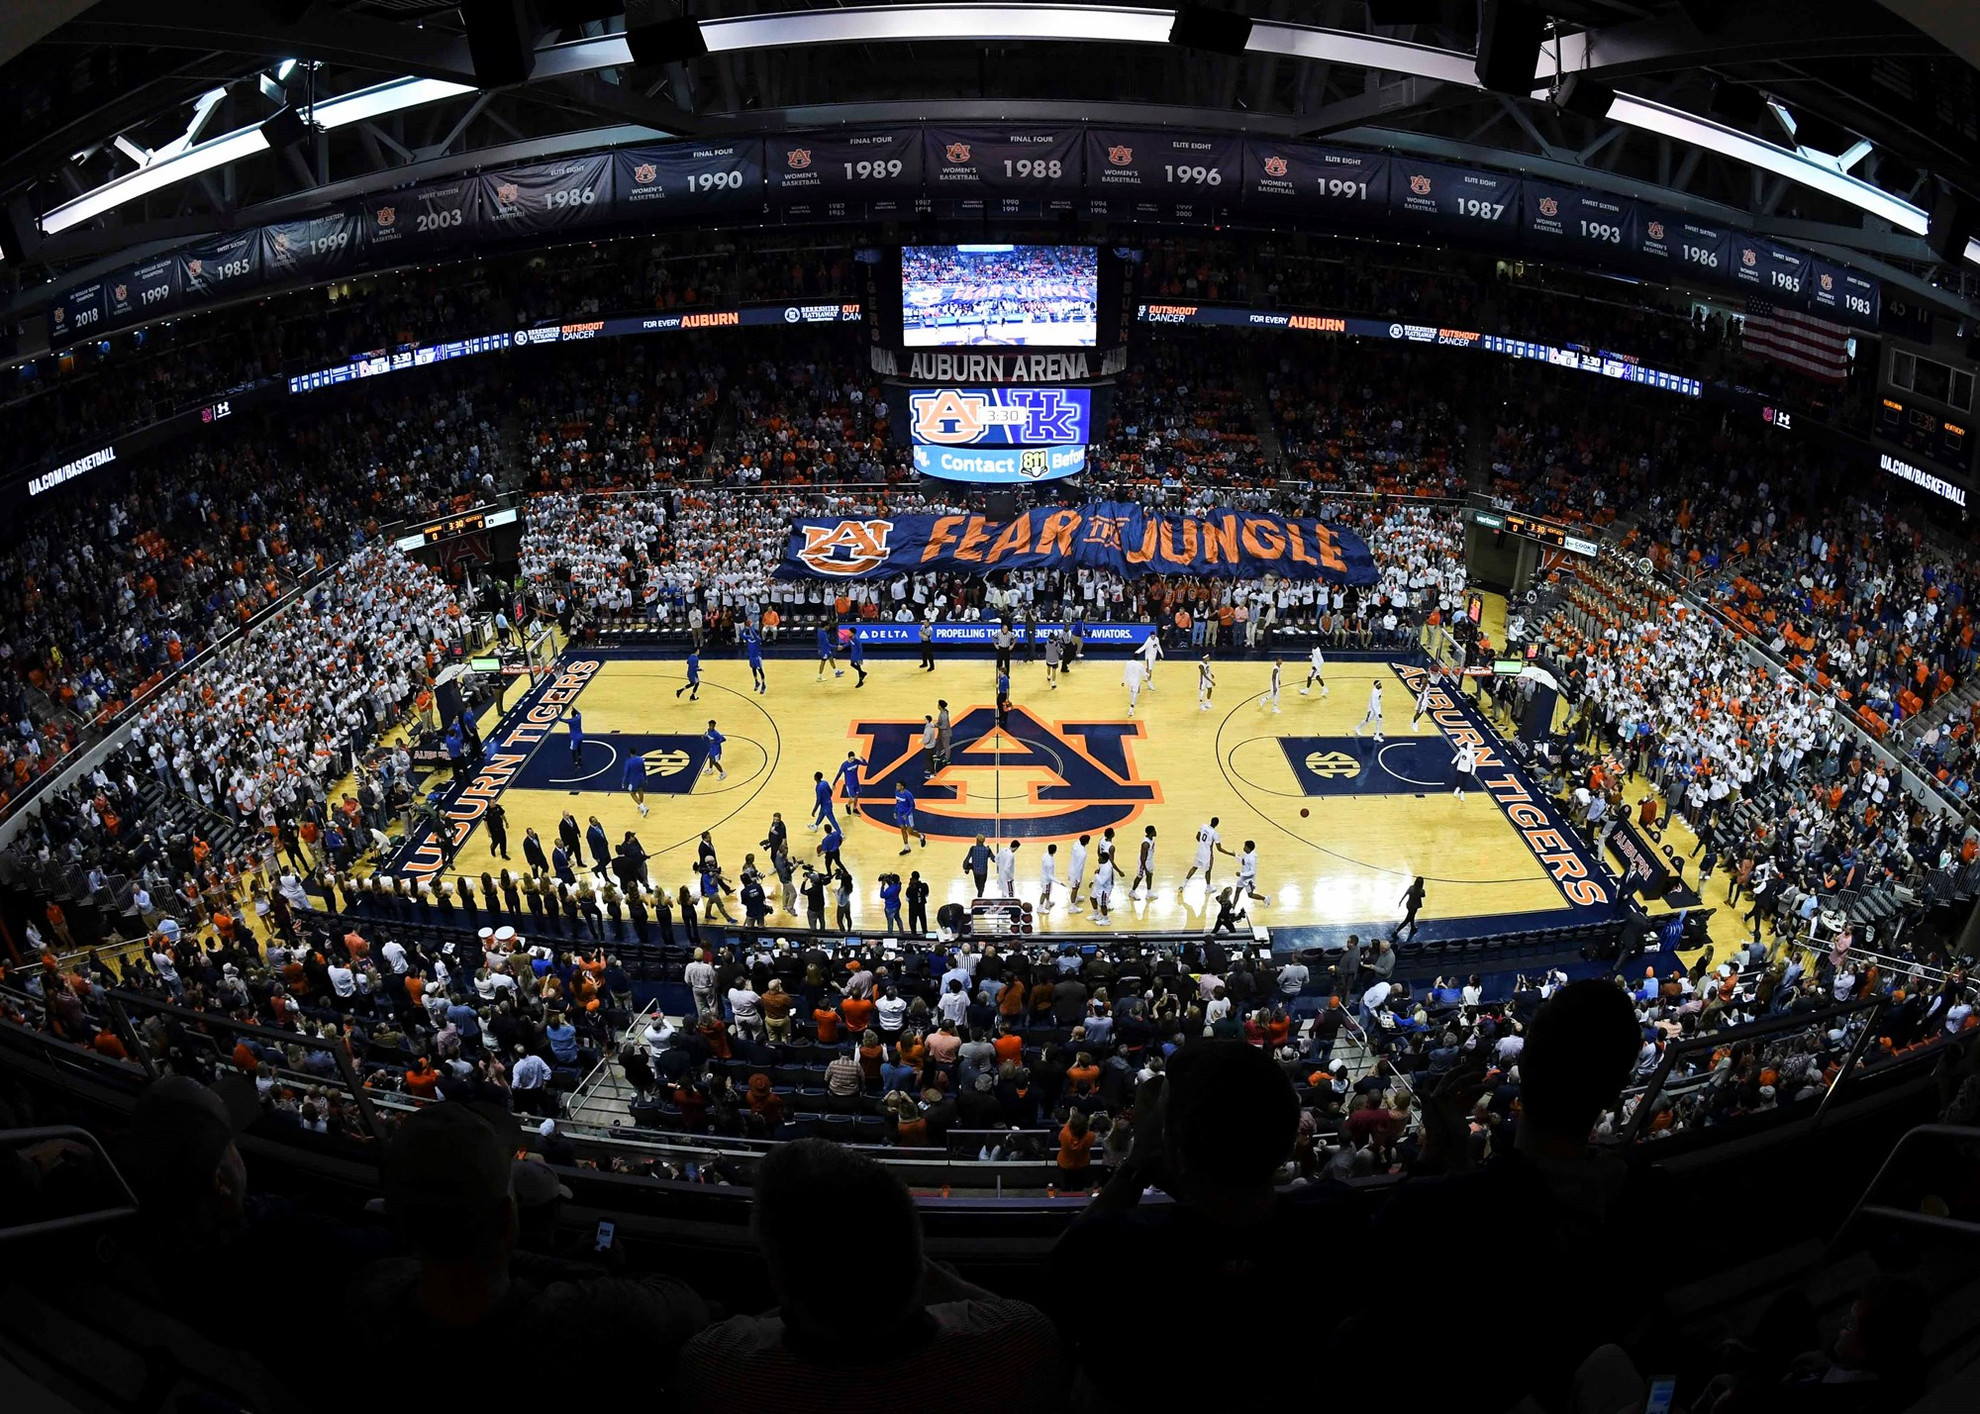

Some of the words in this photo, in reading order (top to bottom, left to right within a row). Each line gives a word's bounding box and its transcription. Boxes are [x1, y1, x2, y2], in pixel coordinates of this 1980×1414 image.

[849, 137, 872, 145] FINAL
[873, 136, 893, 144] FOUR
[1172, 141, 1190, 149] ELITE
[1191, 142, 1212, 150] EIGHT
[693, 149, 714, 158] FINAL
[714, 148, 734, 156] FOUR
[1325, 155, 1341, 164] ELITE
[1342, 157, 1362, 166] EIGHT
[551, 168, 566, 176] ELITE
[566, 165, 585, 174] EIGHT
[843, 159, 903, 180] 1989
[1004, 159, 1062, 179] 1988
[1104, 169, 1139, 177] WOMEN'S
[687, 170, 743, 193] 1990
[784, 172, 818, 180] WOMEN'S
[1101, 175, 1141, 184] BASKETBALL
[1164, 165, 1222, 186] 1996
[781, 178, 821, 187] BASKETBALL
[1260, 178, 1293, 188] WOMEN'S
[1464, 176, 1479, 185] ELITE
[1479, 178, 1497, 188] EIGHT
[631, 185, 663, 195] WOMEN'S
[1257, 185, 1296, 195] BASKETBALL
[1317, 177, 1368, 200] 1991
[545, 187, 595, 210] 1986
[629, 192, 666, 201] BASKETBALL
[1406, 196, 1436, 207] WOMEN'S
[498, 204, 518, 213] MEN'S
[1404, 203, 1438, 214] BASKETBALL
[1457, 197, 1505, 221] 1987
[1581, 198, 1599, 208] SWEET
[1599, 202, 1620, 213] SIXTEEN
[416, 208, 463, 233] 2003
[491, 211, 527, 222] BASKETBALL
[1535, 217, 1562, 228] WOMEN'S
[378, 228, 396, 236] MEN'S
[1533, 223, 1564, 235] BASKETBALL
[1580, 220, 1621, 244] 1993
[310, 233, 349, 256] 1999
[371, 233, 403, 244] BASKETBALL
[1644, 240, 1668, 251] WOMEN'S
[1683, 244, 1718, 268] 1986
[217, 258, 250, 280] 1985
[1771, 271, 1800, 293] 1985
[141, 285, 169, 305] 1999
[800, 305, 840, 313] BERKSHIRE
[1149, 305, 1198, 316] OUTSHOOT
[1845, 294, 1871, 315] 1983
[75, 308, 99, 328] 2018
[643, 321, 659, 329] FOR
[658, 318, 681, 328] EVERY
[680, 312, 739, 329] AUBURN
[1148, 313, 1186, 323] CANCER
[1250, 314, 1265, 323] FOR
[1265, 315, 1288, 325] EVERY
[1288, 315, 1346, 332] AUBURN
[562, 322, 605, 333] OUTSHOOT
[562, 330, 595, 341] CANCER
[1439, 328, 1480, 341] OUTSHOOT
[1438, 336, 1470, 347] CANCER
[392, 352, 412, 364] 3:30
[1582, 354, 1601, 367] 3:30
[910, 353, 1004, 382] AUBURN
[1012, 352, 1090, 382] ARENA
[987, 410, 1018, 422] 3:30
[940, 454, 1015, 473] Contact
[1023, 452, 1046, 469] 811
[28, 446, 116, 496] UA.COM/BASKETBALL
[1880, 453, 1966, 507] UA.COM/BASKETBALL
[449, 519, 465, 531] 3:30
[477, 520, 484, 529] 0
[1476, 515, 1501, 527] verizon
[1512, 524, 1518, 532] 0
[1530, 523, 1546, 534] 3:30
[432, 532, 438, 541] 0
[920, 509, 1083, 564] FEAR
[1084, 514, 1130, 551] THE
[1126, 513, 1348, 574] JUNGLE
[1558, 537, 1563, 545] 0
[1574, 541, 1597, 551] COOK'S
[872, 629, 908, 639] DELTA
[936, 629, 990, 639] PROPELLING
[990, 629, 1002, 638] TH
[1091, 628, 1133, 639] AVIATORS.
[503, 660, 600, 747] TIGERS
[1305, 750, 1361, 779] SEC
[1391, 662, 1505, 768] AUBURN
[1485, 772, 1610, 907] TIGERS
[1202, 833, 1207, 842] 0
[1612, 830, 1653, 882] AUBURN
